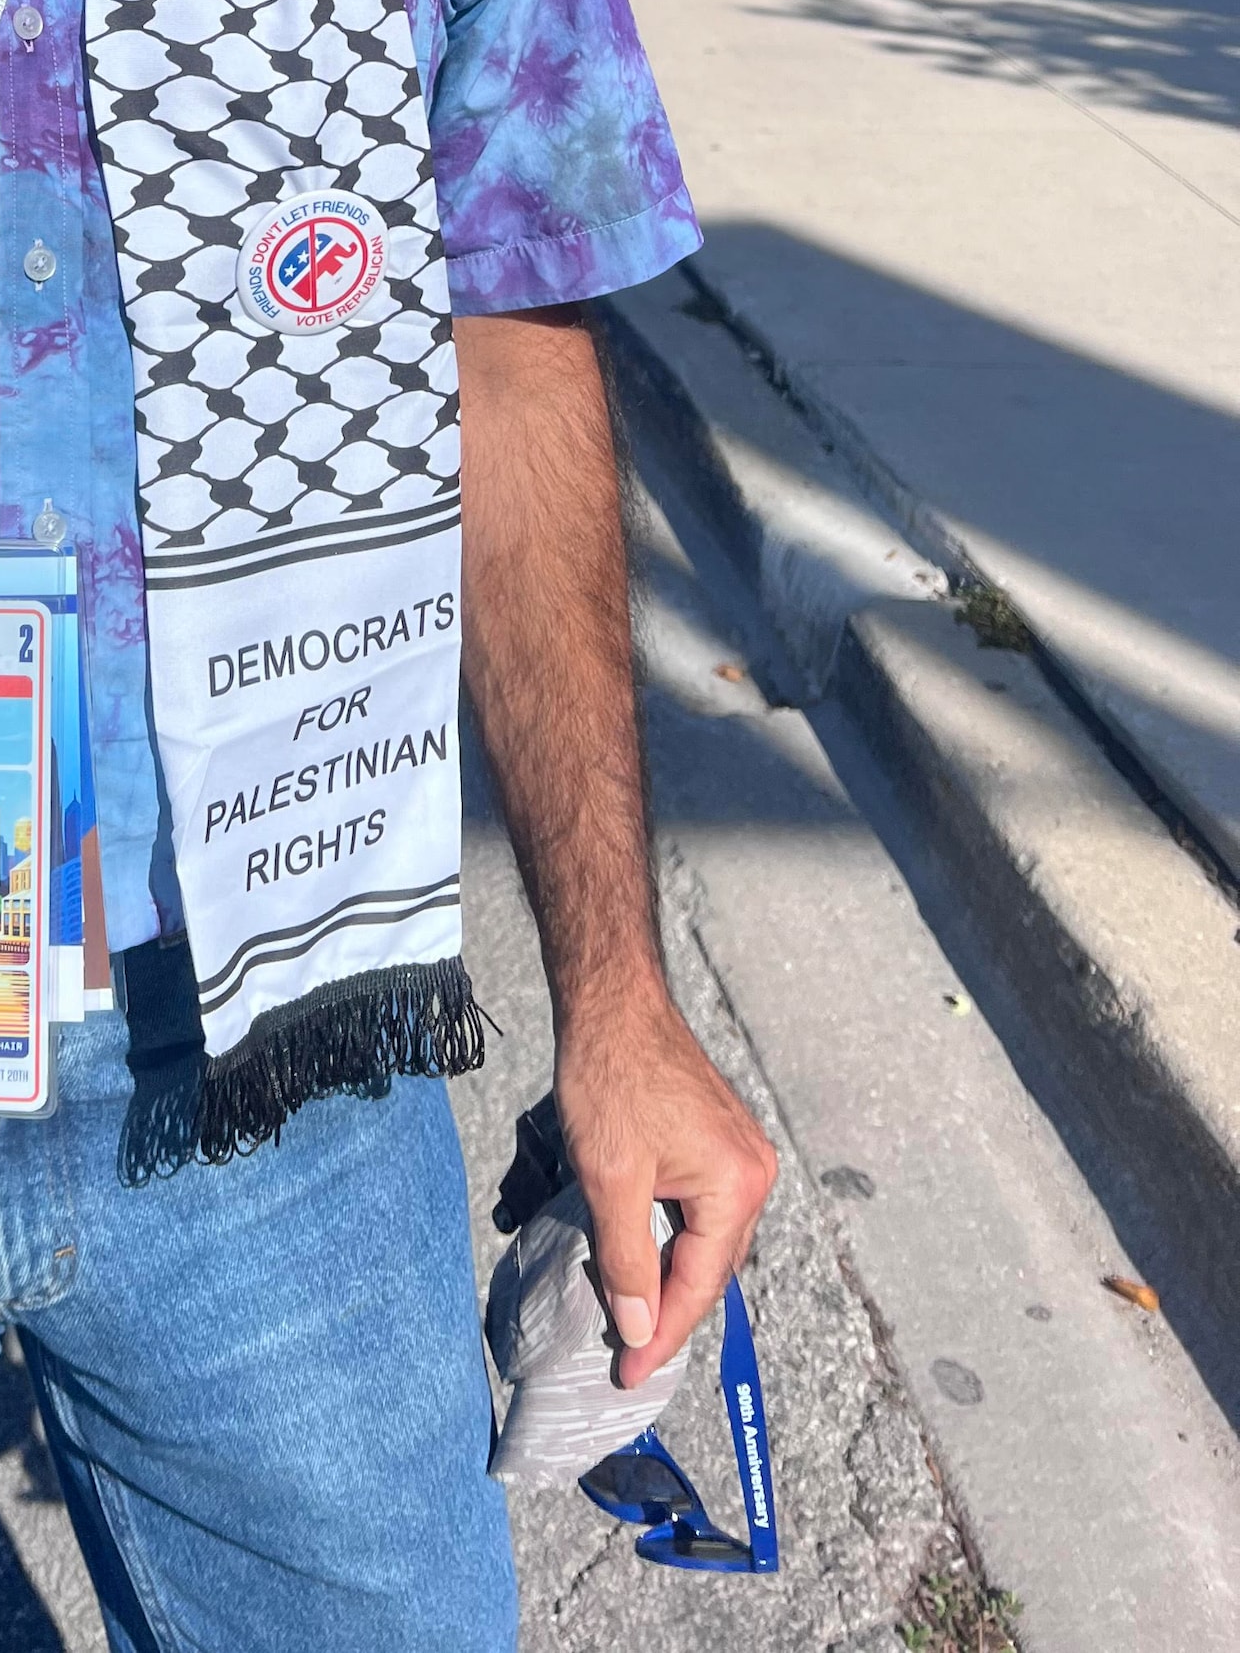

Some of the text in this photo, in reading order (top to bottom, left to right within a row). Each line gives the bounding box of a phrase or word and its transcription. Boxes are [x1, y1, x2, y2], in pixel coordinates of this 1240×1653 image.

[249, 200, 370, 319] FRIENDS DON'T LET FRIENDS
[296, 235, 384, 327] VOTE REPUBLICAN
[18, 624, 33, 663] 2
[208, 592, 454, 698] DEMOCRATS
[293, 685, 371, 741] FOR
[204, 723, 447, 844] PALESTINIAN
[246, 808, 386, 892] RIGHTS
[7, 1069, 29, 1083] 20TH
[736, 1383, 770, 1529] 90th Anniversary
